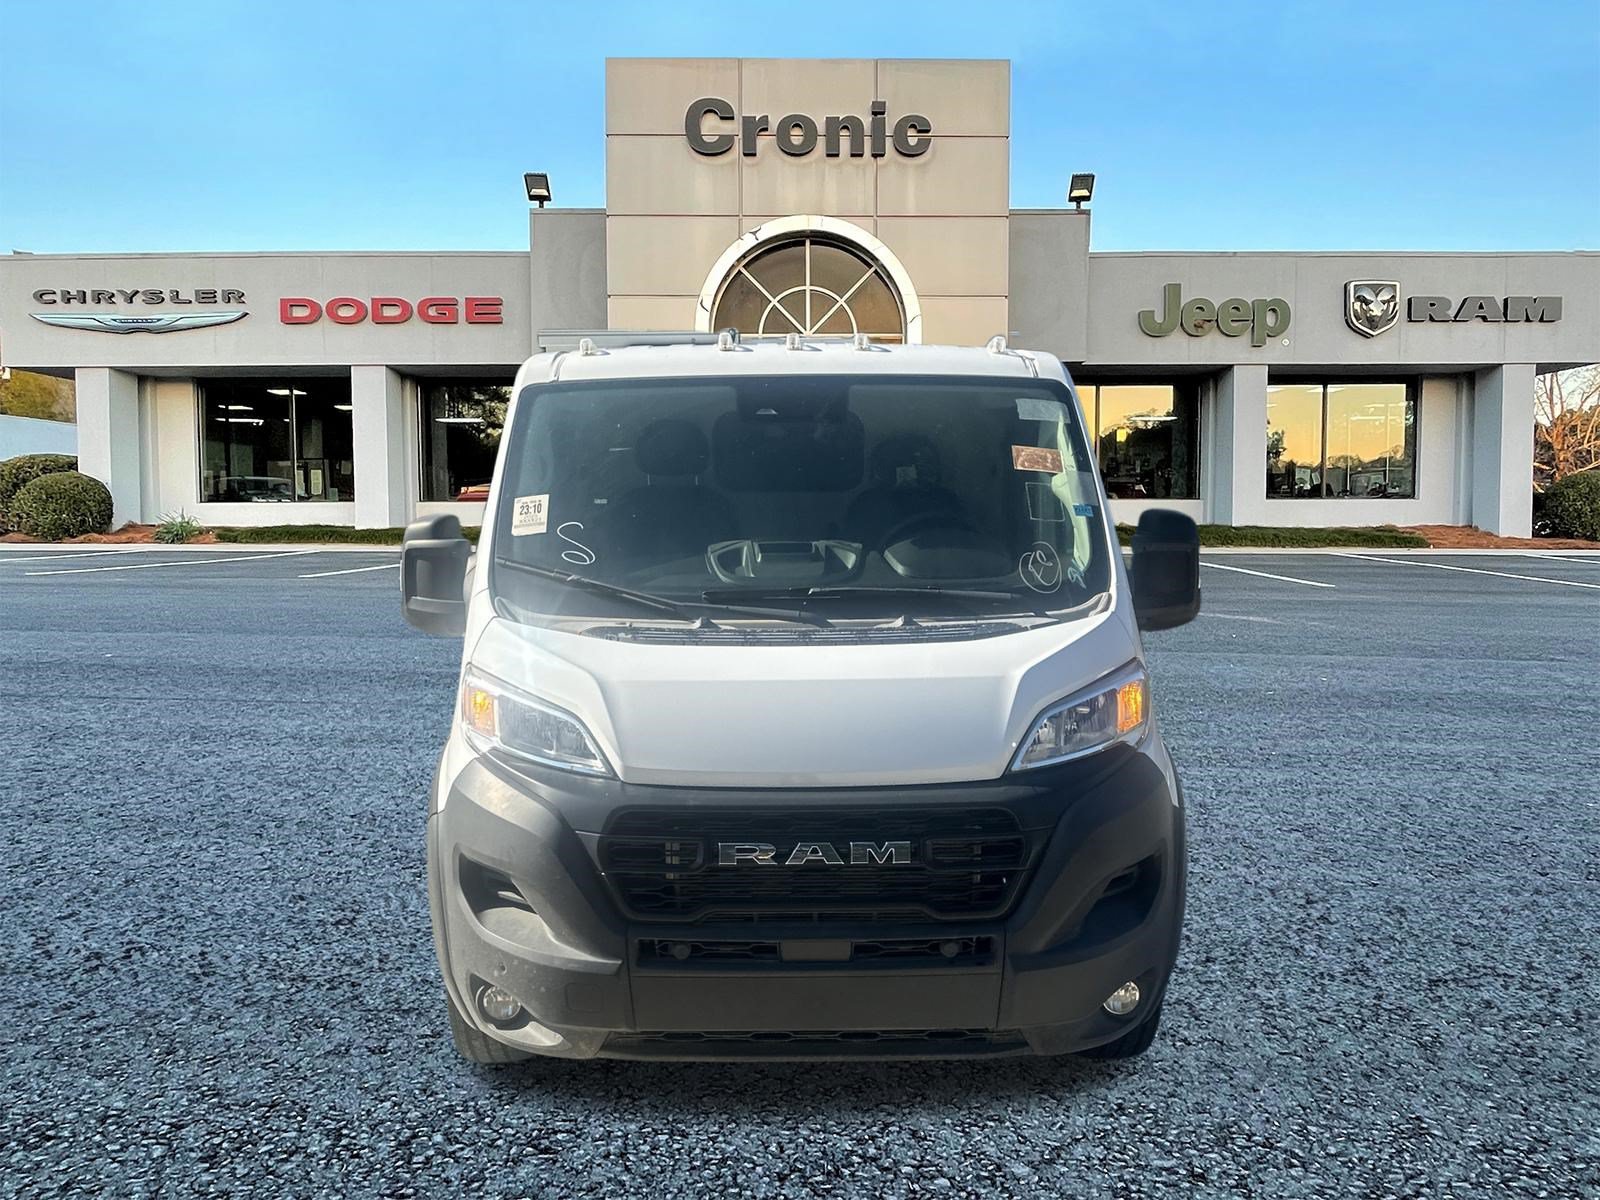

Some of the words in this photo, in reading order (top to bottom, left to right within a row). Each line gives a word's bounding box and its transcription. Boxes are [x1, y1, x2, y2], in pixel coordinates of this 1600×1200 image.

[685, 97, 932, 157] Cronic
[32, 289, 246, 304] CHRYSLER
[1407, 296, 1562, 323] RAM
[280, 297, 503, 325] DODGE
[1138, 283, 1291, 347] Jeep
[718, 841, 911, 865] RAM
